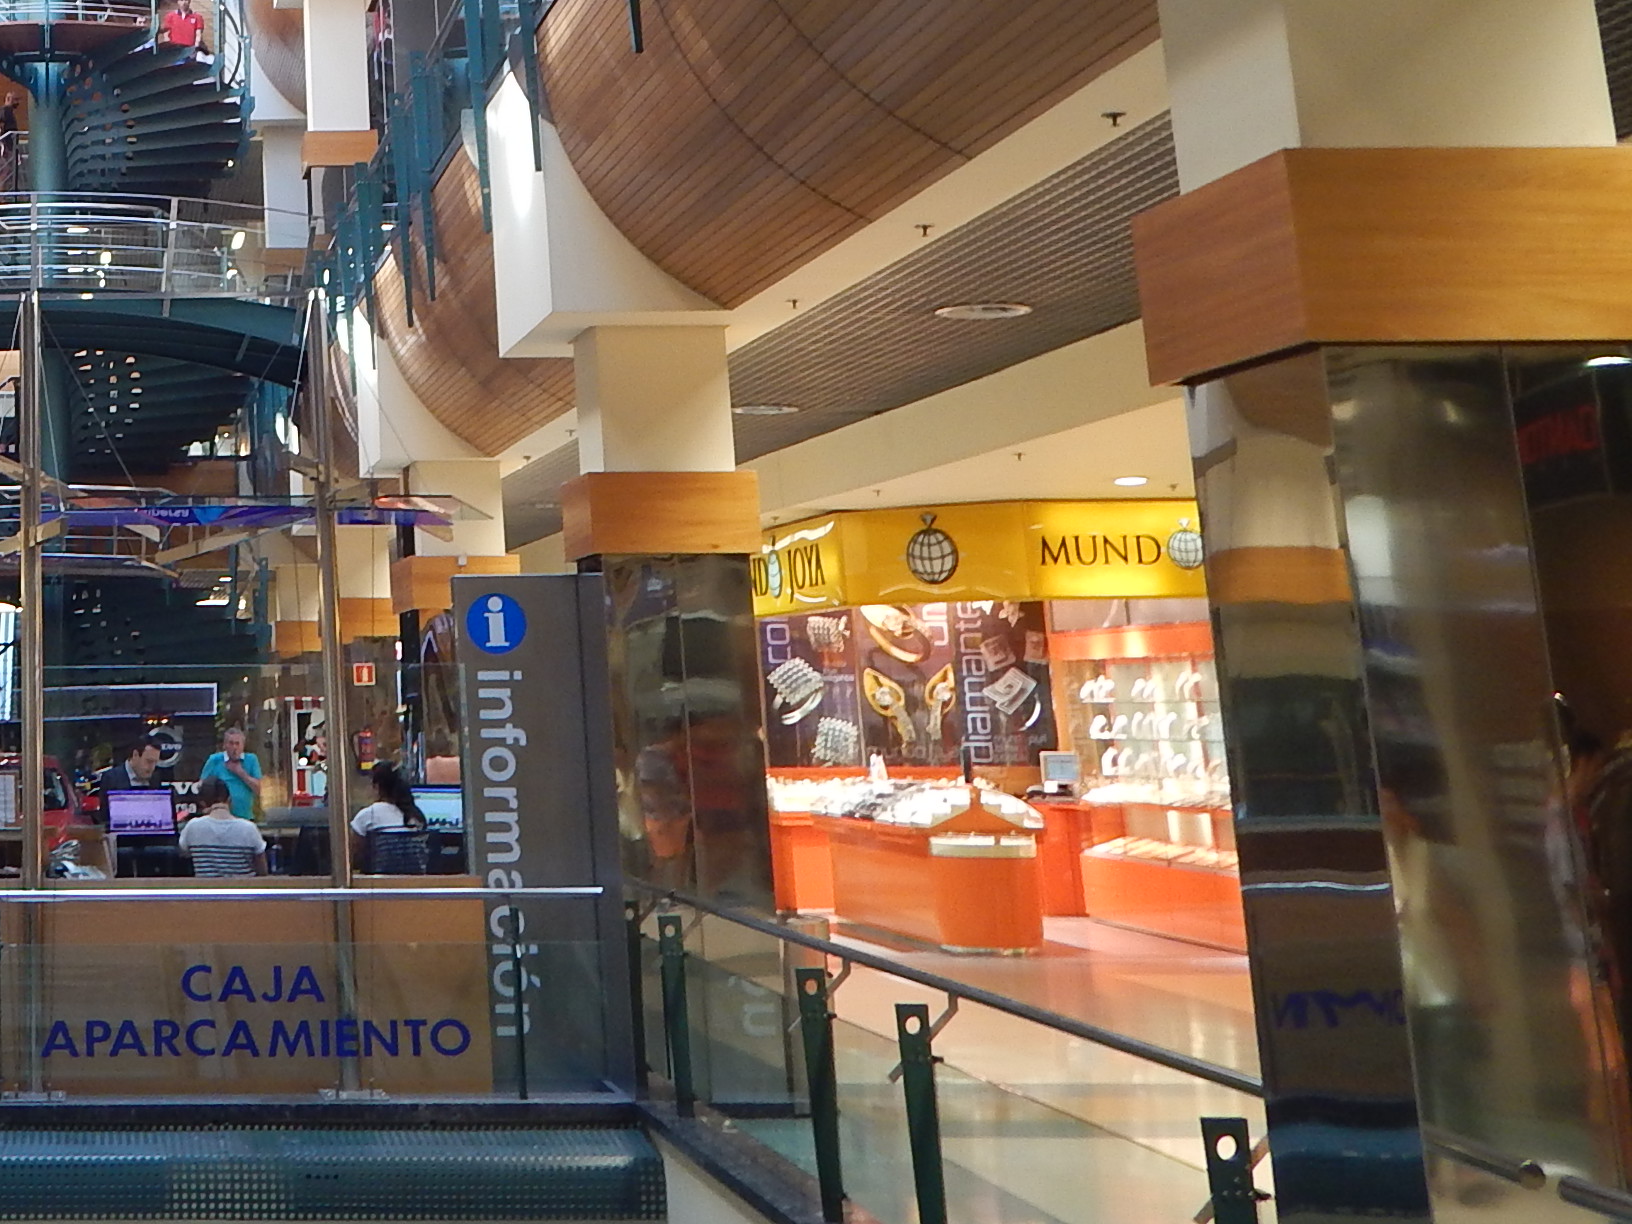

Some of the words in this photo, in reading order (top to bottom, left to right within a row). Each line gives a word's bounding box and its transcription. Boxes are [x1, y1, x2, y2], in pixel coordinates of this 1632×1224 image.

[787, 542, 826, 604] JOYA
[477, 669, 540, 1037] información
[180, 963, 325, 1004] CAJA
[40, 1017, 471, 1059] APARCAMIENTO
